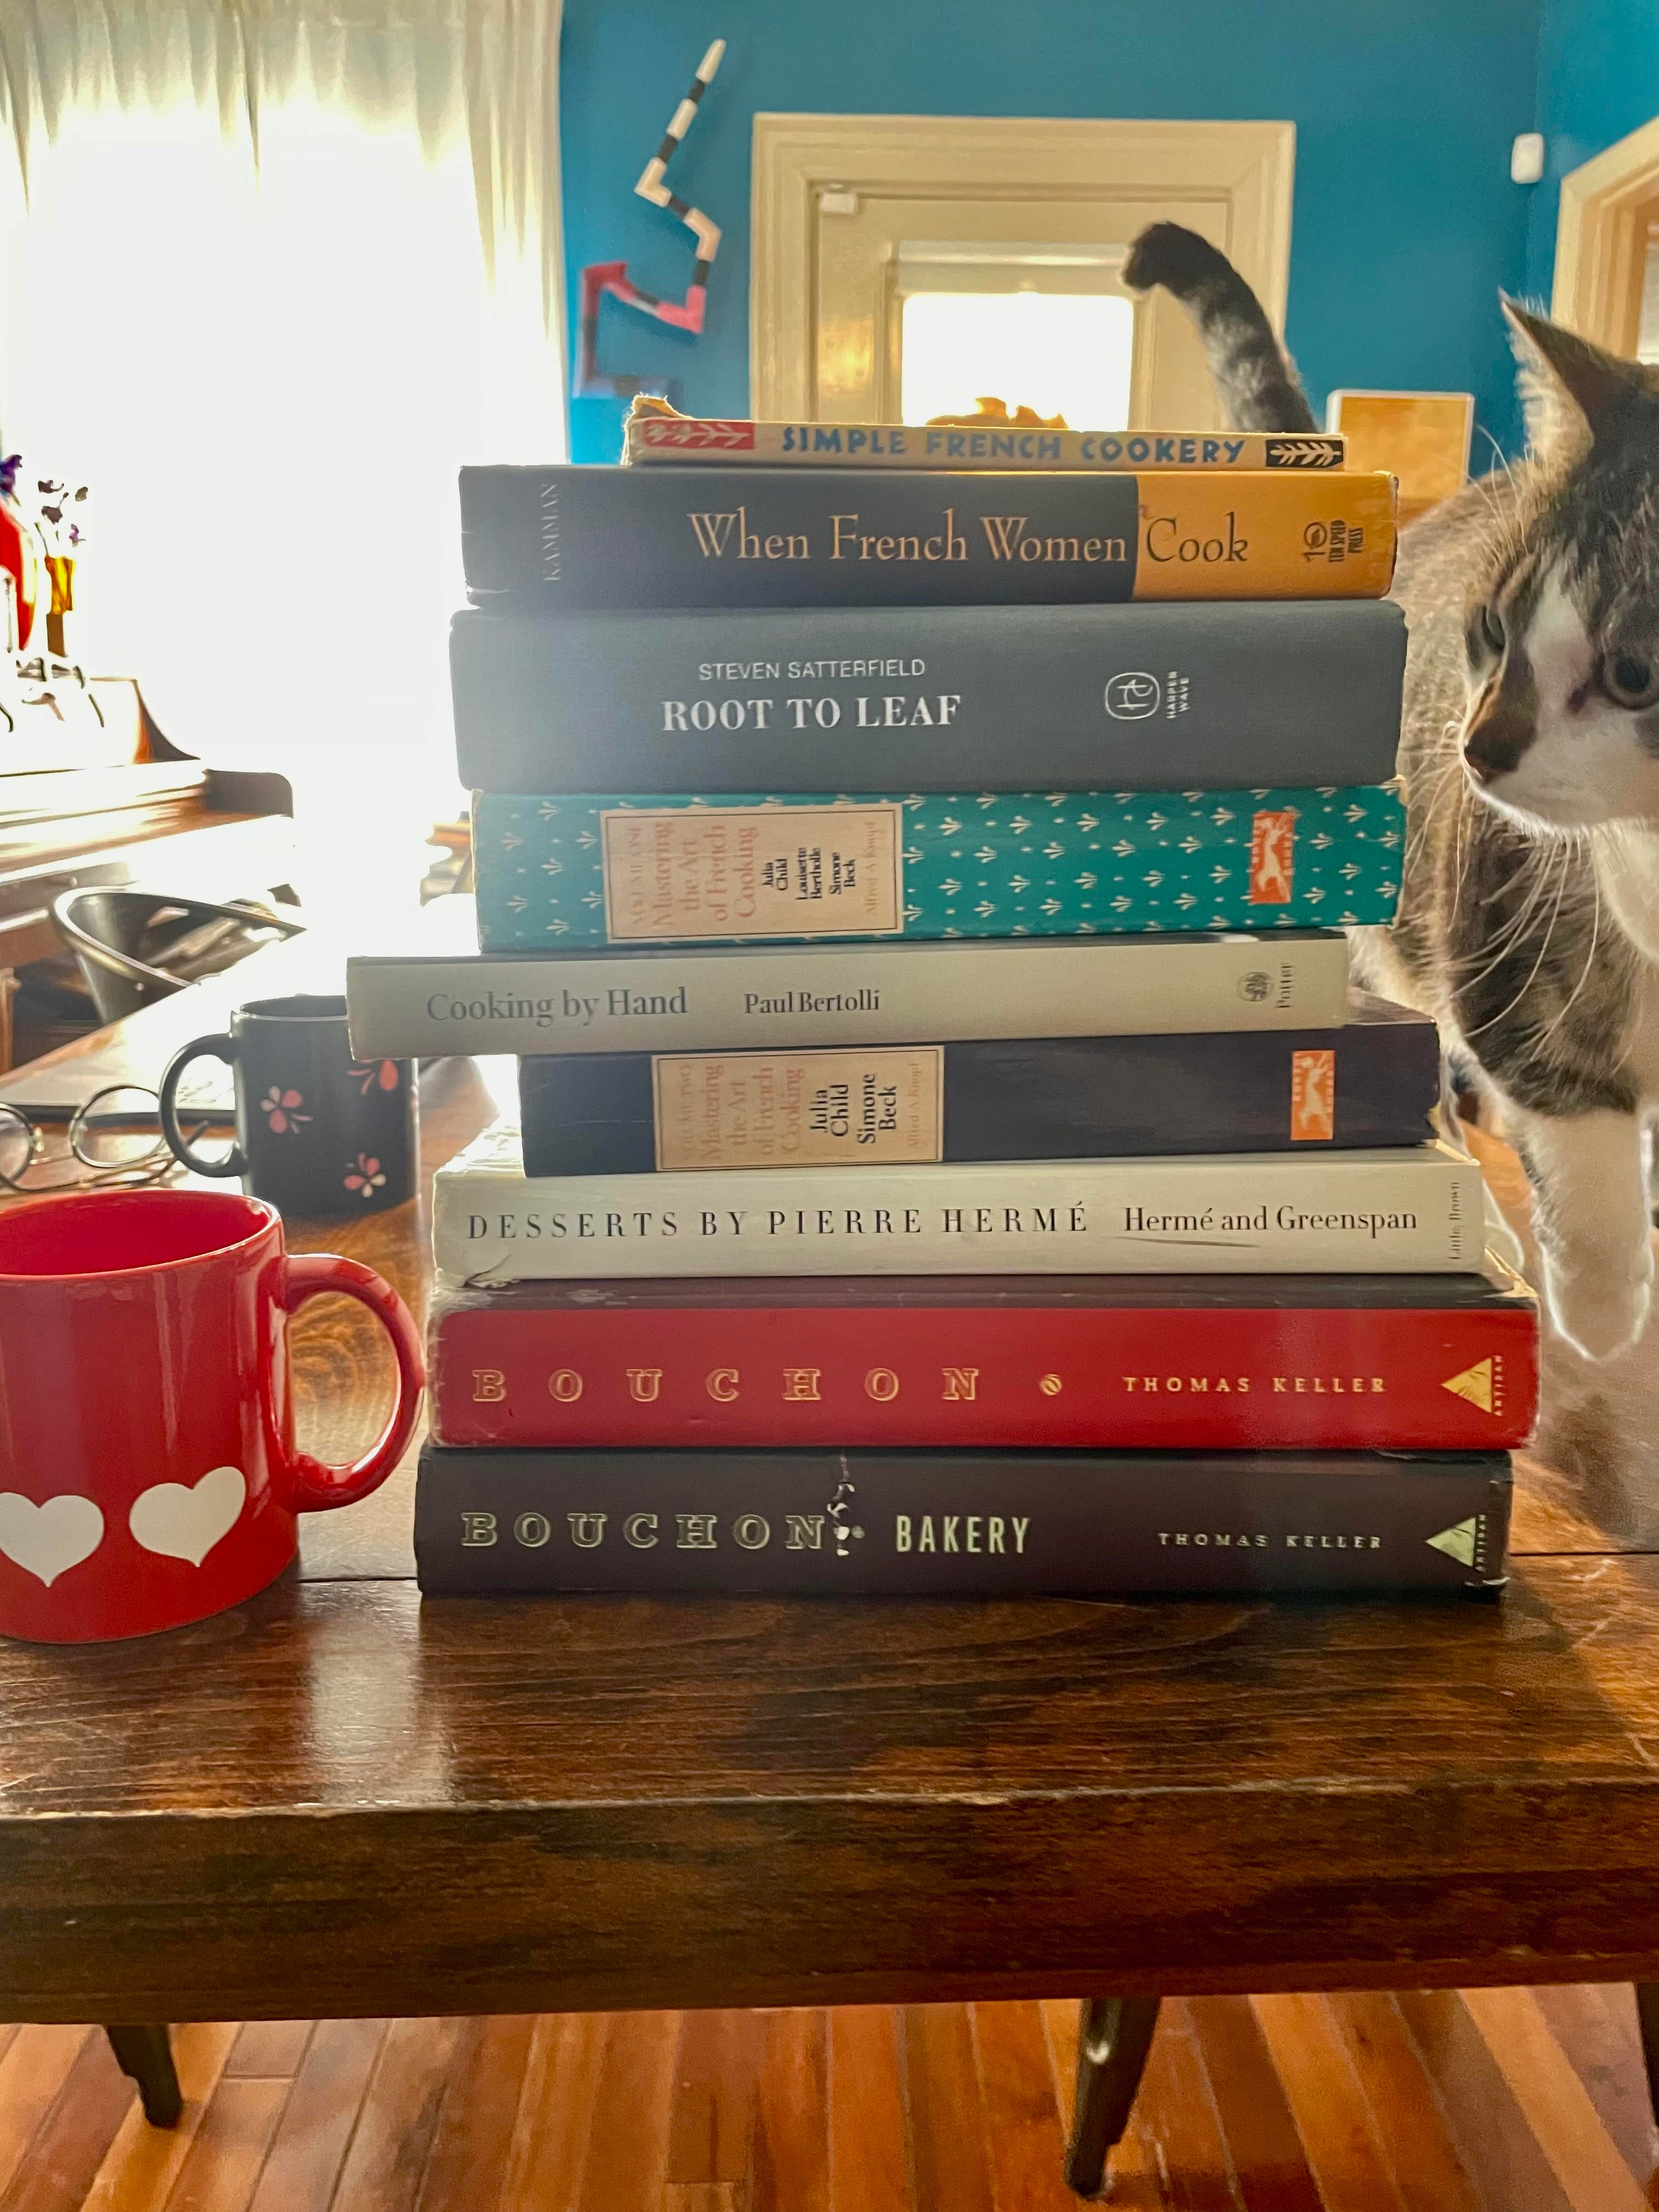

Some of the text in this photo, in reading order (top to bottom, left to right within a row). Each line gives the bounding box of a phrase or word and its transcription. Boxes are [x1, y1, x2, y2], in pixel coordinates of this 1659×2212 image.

[783, 426, 1245, 463] SIMPLE FRENCH COOKERY
[687, 507, 1249, 564] When French Women Cook
[698, 659, 925, 681] STEVEN SATTERFIELD
[661, 695, 961, 731] ROOT TO LEAF
[679, 840, 700, 912] the Art
[704, 825, 728, 895] French
[733, 827, 758, 918] Cooking
[761, 862, 774, 888] Julia
[775, 858, 788, 890] Child
[809, 847, 821, 900] Bertholle
[829, 852, 842, 894] Simone
[843, 859, 856, 888] Beck
[427, 986, 689, 1027] Cooking by Hand
[744, 989, 881, 1014] Paul Bertolli
[728, 1080, 747, 1147] the Art
[780, 1068, 805, 1152] Cooking
[809, 1089, 828, 1133] Julia
[828, 1084, 849, 1137] Child
[856, 1074, 876, 1144] Simone
[877, 1086, 898, 1130] Beck
[466, 1200, 1086, 1239] DESSERTS BY PIERRE HERMÉ
[1124, 1205, 1417, 1239] Hermé and Greenspan
[472, 1368, 979, 1402] BOUCHON
[1123, 1376, 1387, 1393] THOMAS KELLER
[461, 1512, 1030, 1554] BOUCHON BAKERY
[1158, 1533, 1380, 1549] THOMAS KELLER
